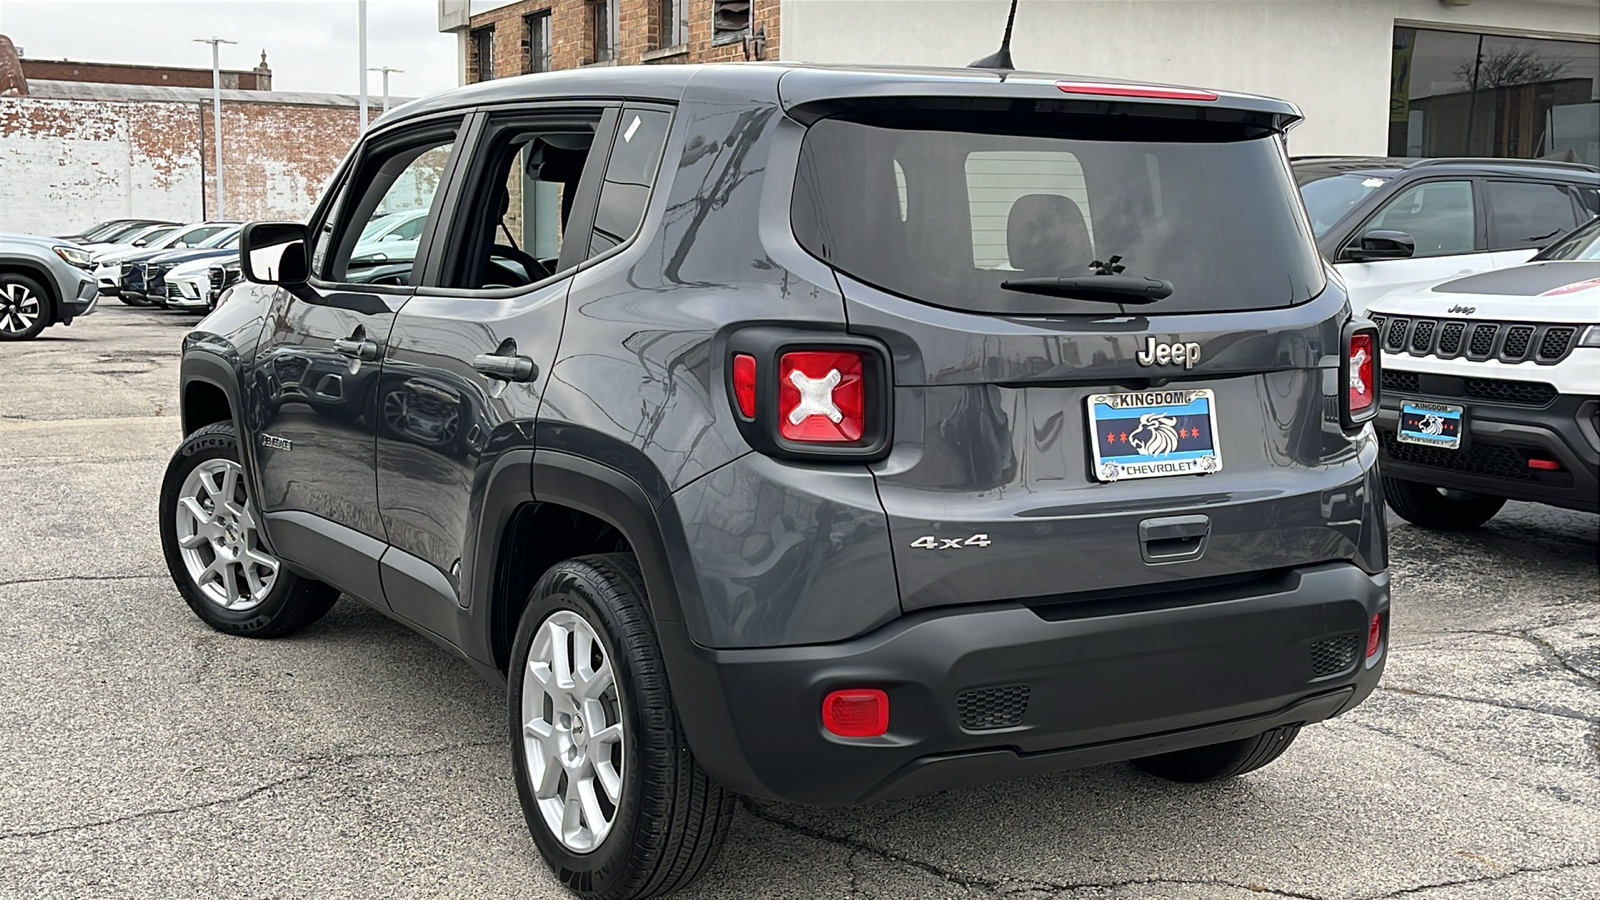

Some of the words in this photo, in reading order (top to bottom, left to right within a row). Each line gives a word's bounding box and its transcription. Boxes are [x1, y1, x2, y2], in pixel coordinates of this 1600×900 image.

[1447, 304, 1476, 316] Jeep
[1137, 336, 1201, 369] Jeep
[1120, 392, 1184, 407] KINGDOM
[1415, 403, 1448, 411] KINGDOM
[1126, 461, 1192, 475] CHEVROLET
[910, 533, 992, 550] 4x4
